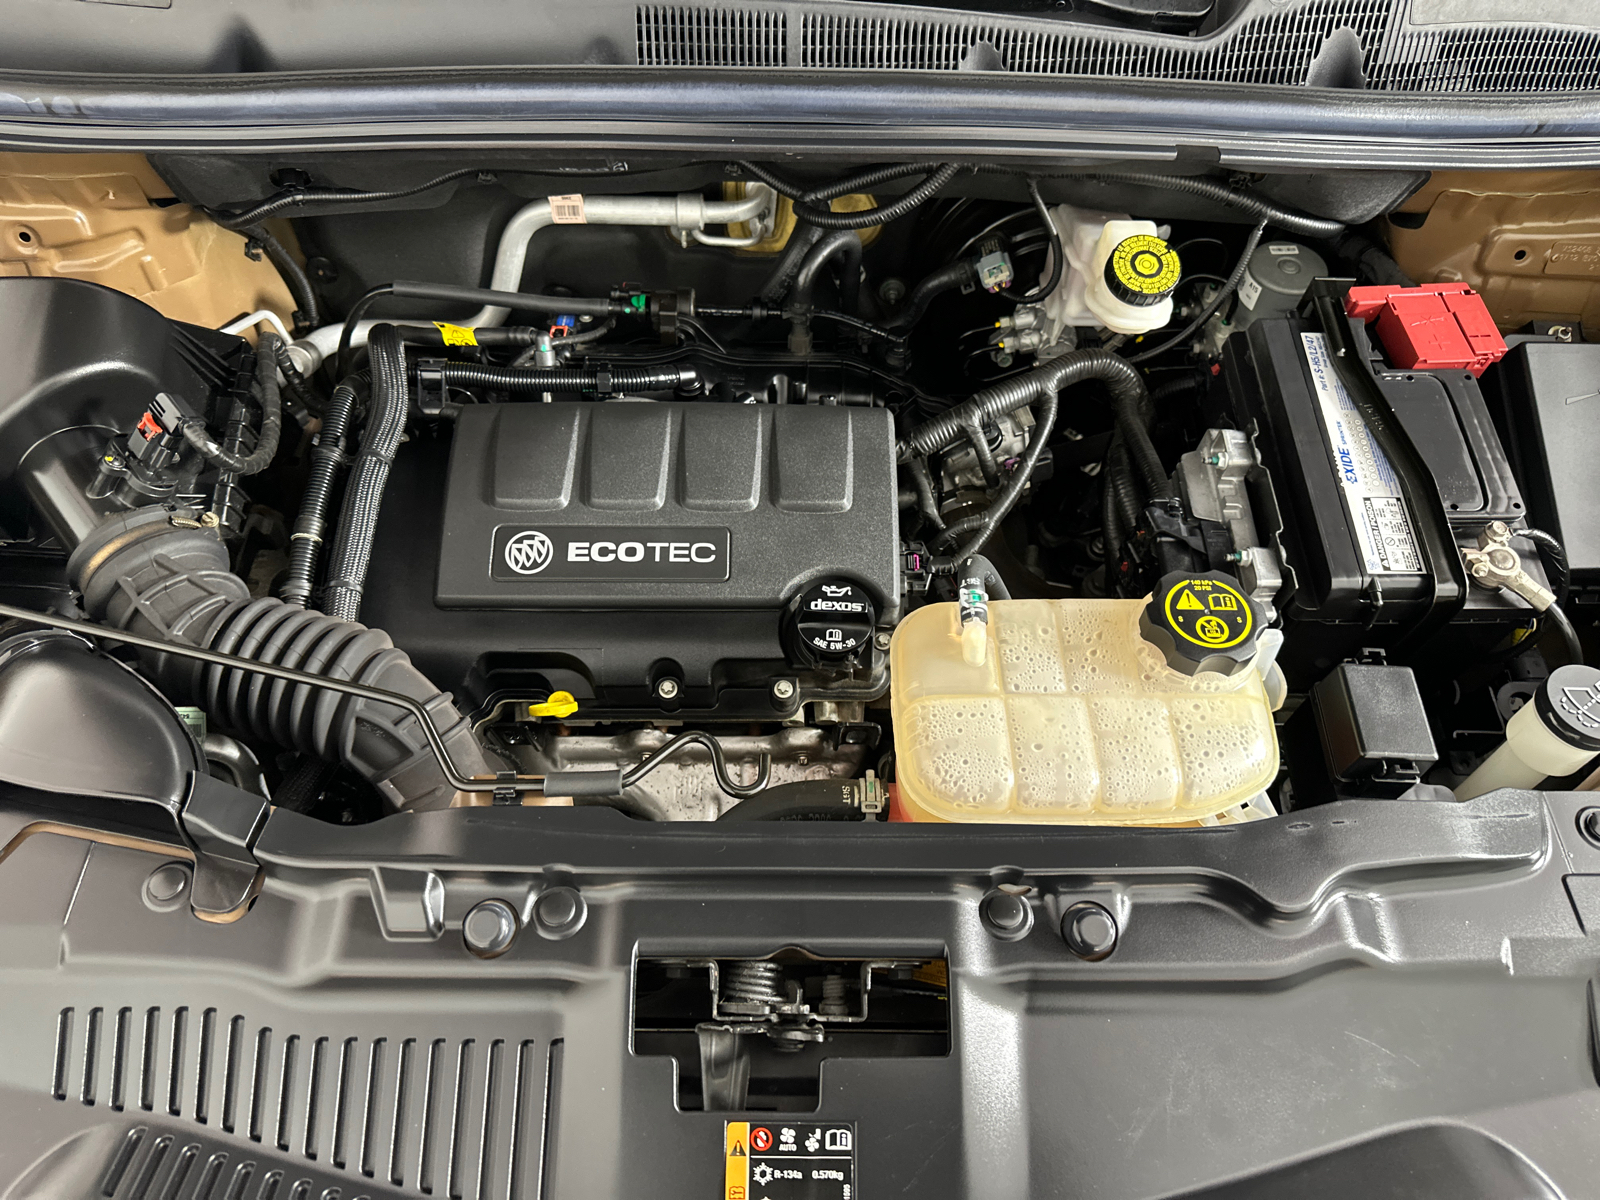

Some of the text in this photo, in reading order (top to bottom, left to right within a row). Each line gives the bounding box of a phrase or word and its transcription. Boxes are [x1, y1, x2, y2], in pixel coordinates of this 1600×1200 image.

[1337, 446, 1358, 484] EXIDE
[567, 541, 717, 563] ECOTEC
[810, 598, 865, 612] dexos
[813, 636, 856, 650] SAE 5W-30
[778, 1143, 797, 1152] AUTO
[773, 1169, 803, 1179] R-134a
